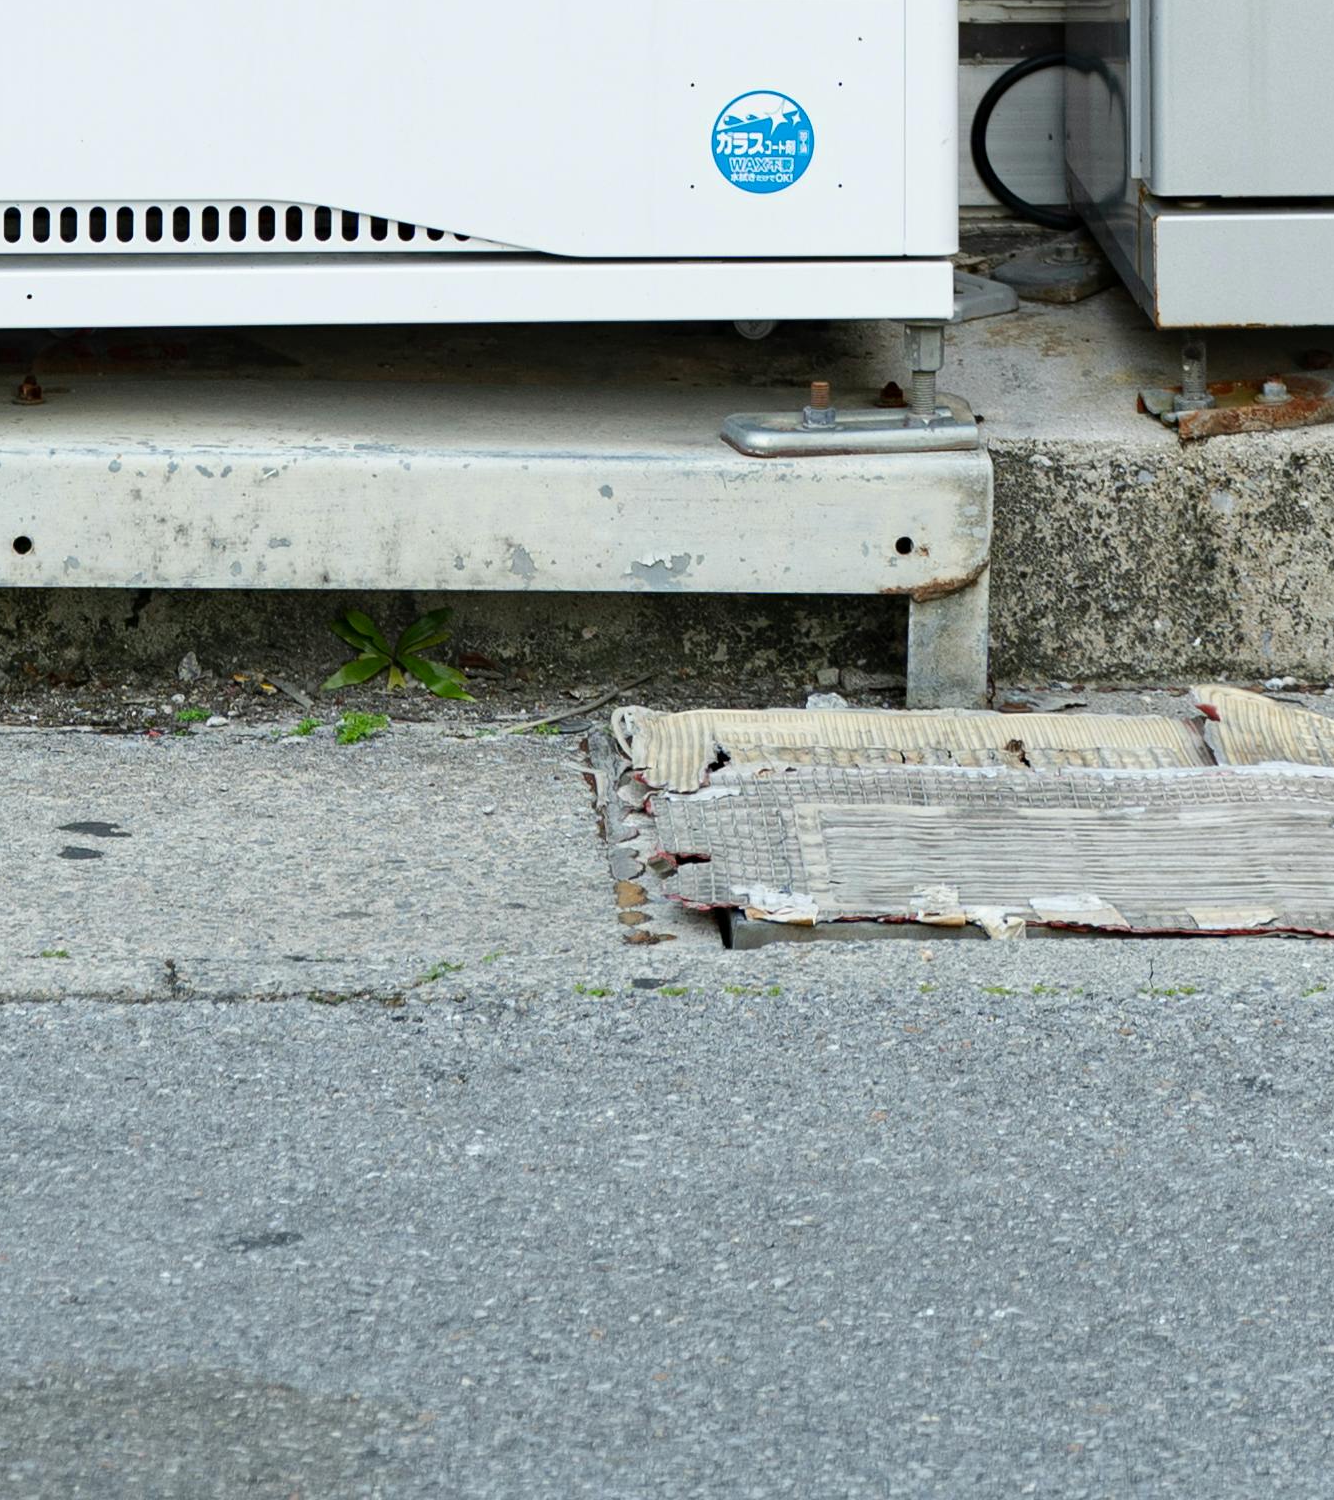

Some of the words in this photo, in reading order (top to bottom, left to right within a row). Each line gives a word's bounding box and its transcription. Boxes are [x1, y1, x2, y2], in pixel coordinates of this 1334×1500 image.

[716, 132, 796, 156] ガラスコート剤
[729, 157, 795, 173] WAX不要
